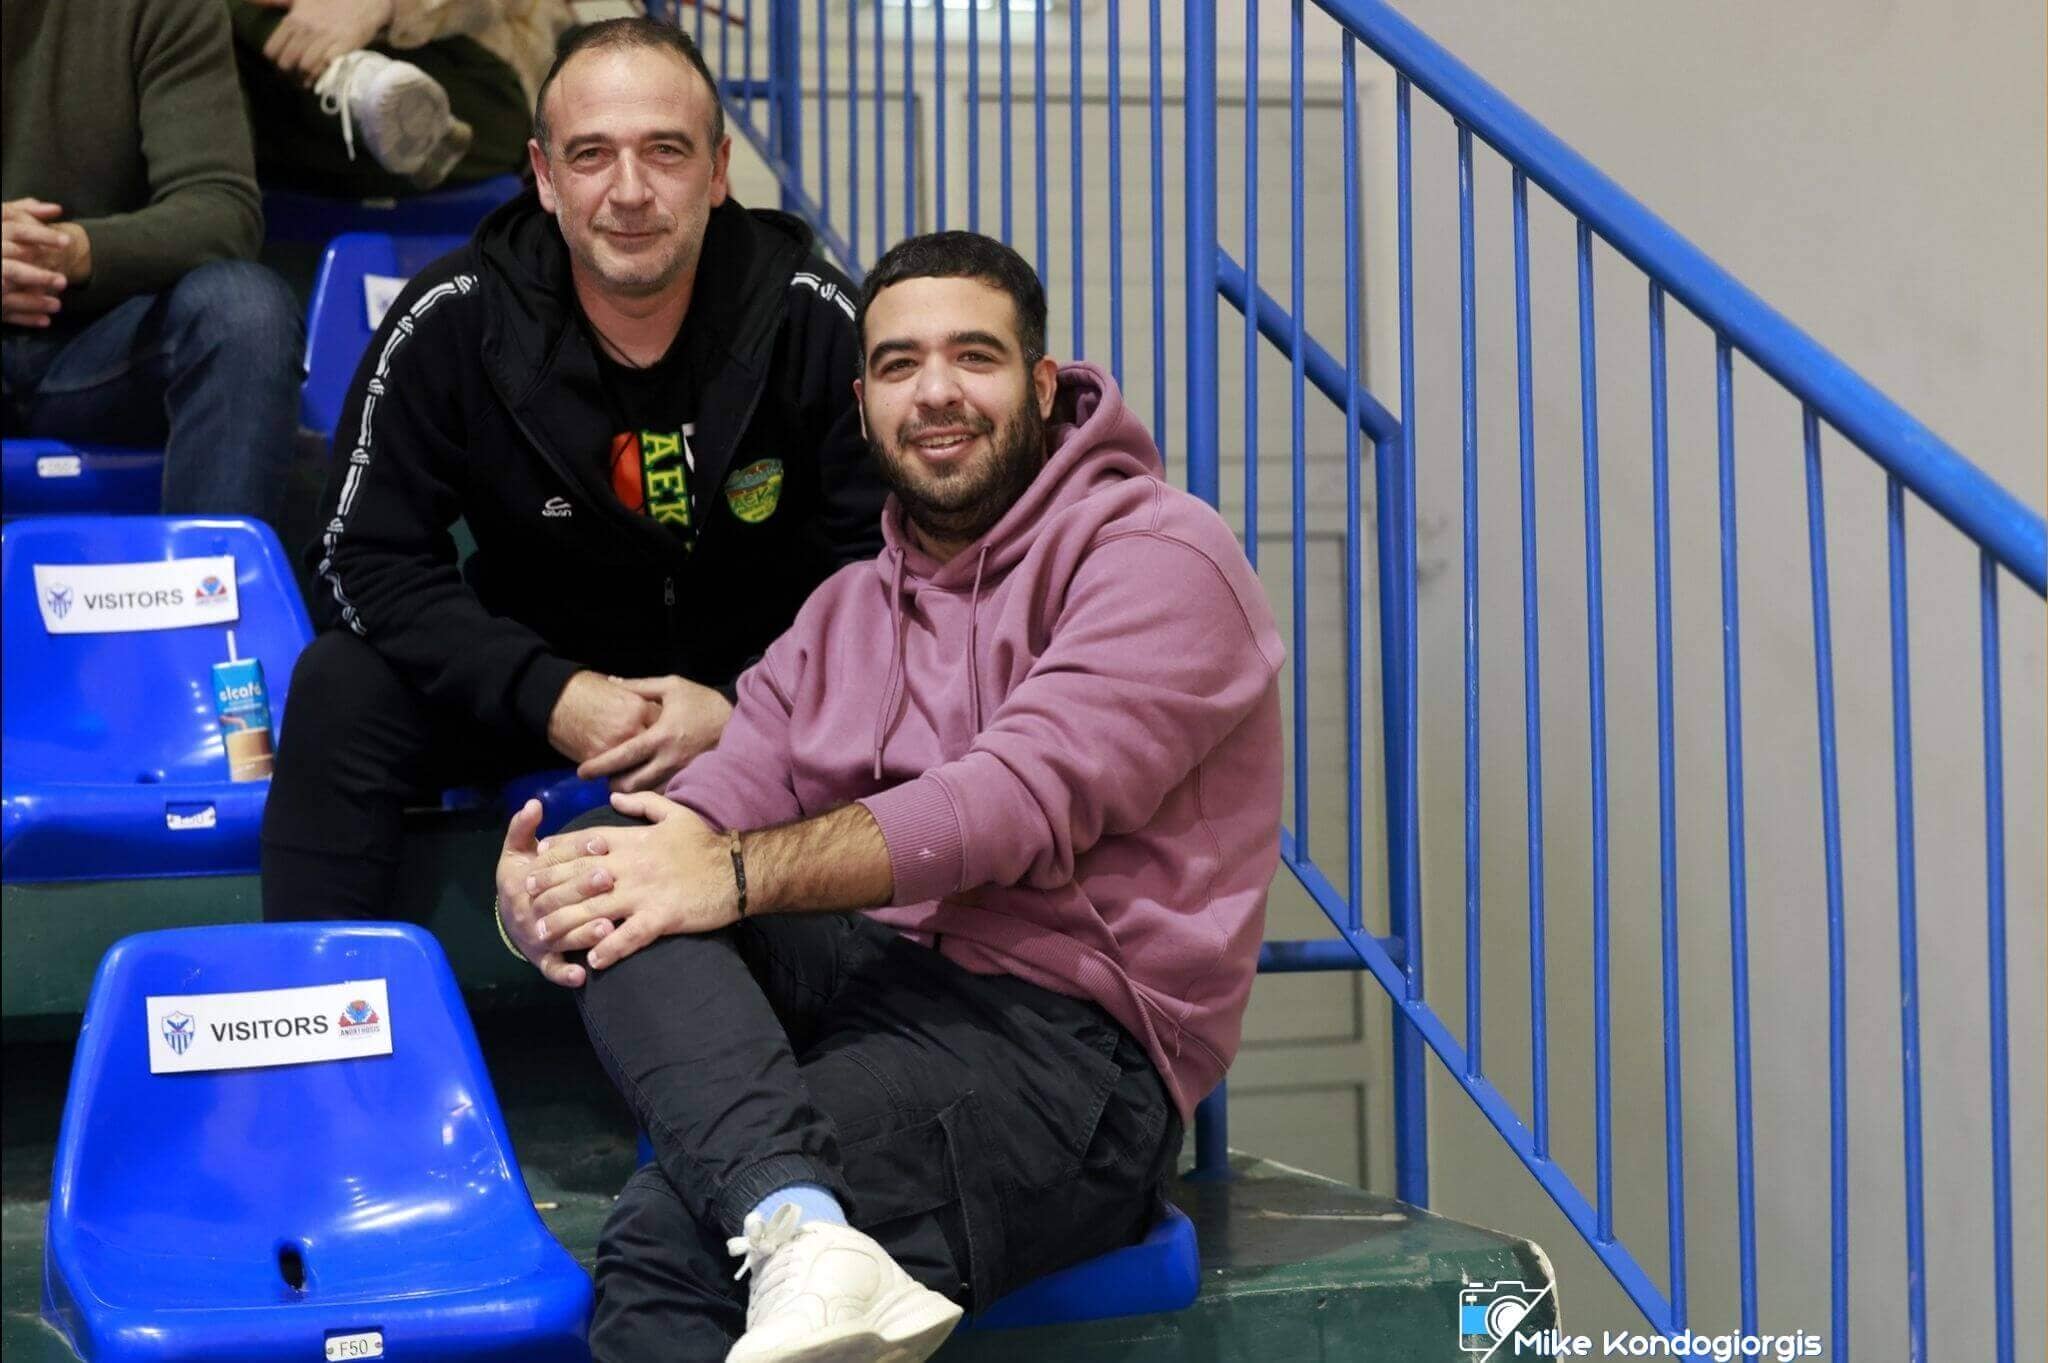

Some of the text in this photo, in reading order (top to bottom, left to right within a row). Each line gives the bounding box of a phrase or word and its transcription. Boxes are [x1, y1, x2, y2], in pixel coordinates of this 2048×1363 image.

[643, 430, 691, 527] AEK
[84, 588, 184, 611] VISITORS
[210, 1015, 329, 1042] VISITORS
[340, 1339, 369, 1357] F50
